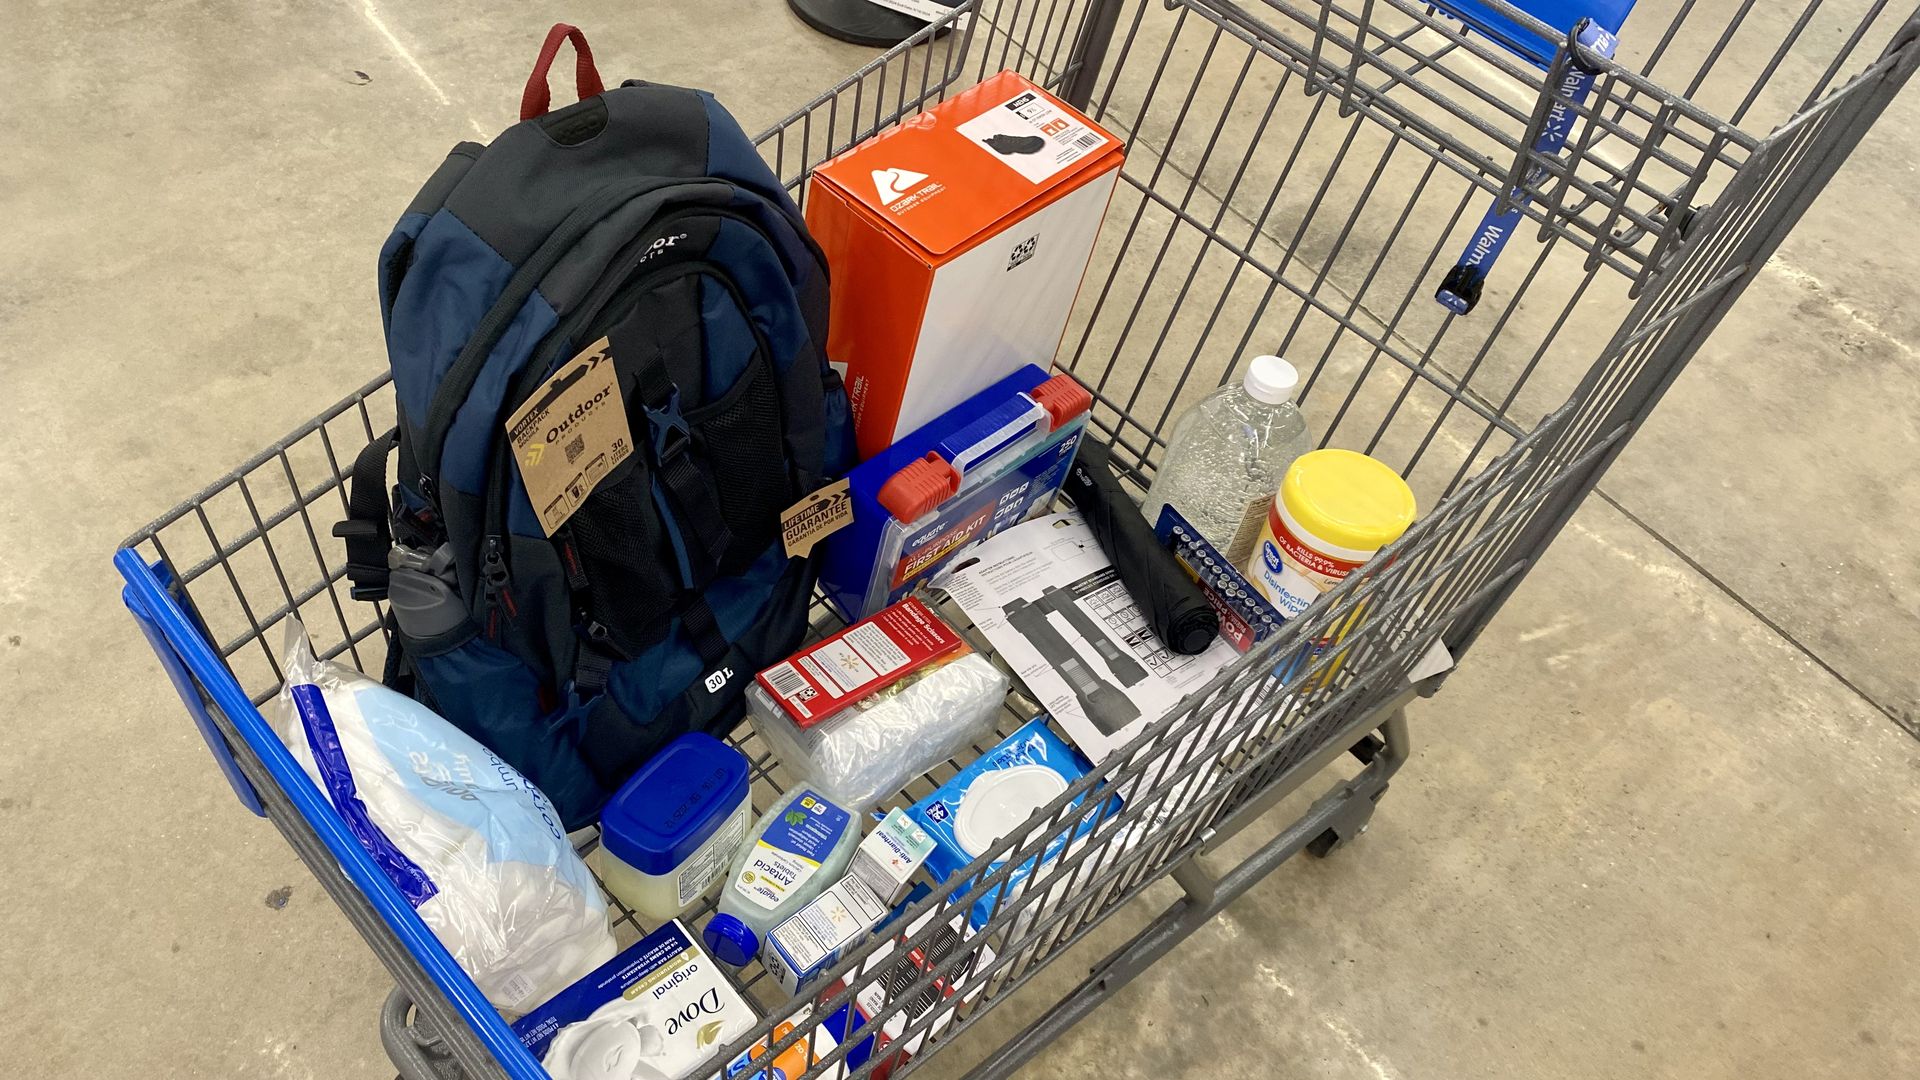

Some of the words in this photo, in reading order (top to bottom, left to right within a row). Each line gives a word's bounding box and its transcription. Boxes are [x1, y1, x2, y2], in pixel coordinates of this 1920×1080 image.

[1465, 223, 1503, 270] Walm
[513, 407, 540, 435] VORTEX
[517, 408, 550, 443] BACKPACK
[546, 384, 612, 443] Outdoor
[611, 438, 624, 453] 30
[1058, 435, 1077, 453] 250
[784, 503, 820, 530] LIFETIME
[786, 501, 847, 540] GUARANTEE
[904, 541, 943, 574] FIRST
[943, 526, 972, 550] AID
[967, 514, 988, 535] KIT
[1279, 535, 1288, 545] OF
[1286, 540, 1317, 570] BACTERIA
[1324, 566, 1350, 577] VIRUS
[1296, 545, 1315, 561] KILLS
[1314, 553, 1335, 569] 99.9%
[1263, 571, 1310, 608] Disinfectin
[901, 602, 925, 626] Bandage
[923, 622, 946, 644] Scissors
[708, 675, 722, 689] 30
[722, 667, 734, 680] L
[875, 829, 912, 864] Anti-Diarrheal
[753, 858, 793, 887] Antacid
[773, 860, 796, 879] Tablets
[756, 886, 779, 902] equate
[664, 936, 675, 945] PAIN
[665, 945, 682, 959] BEAUTY
[621, 959, 649, 979] HYDRATANTE
[657, 956, 666, 964] BAR
[649, 960, 700, 1000] original
[660, 985, 727, 1040] Dove
